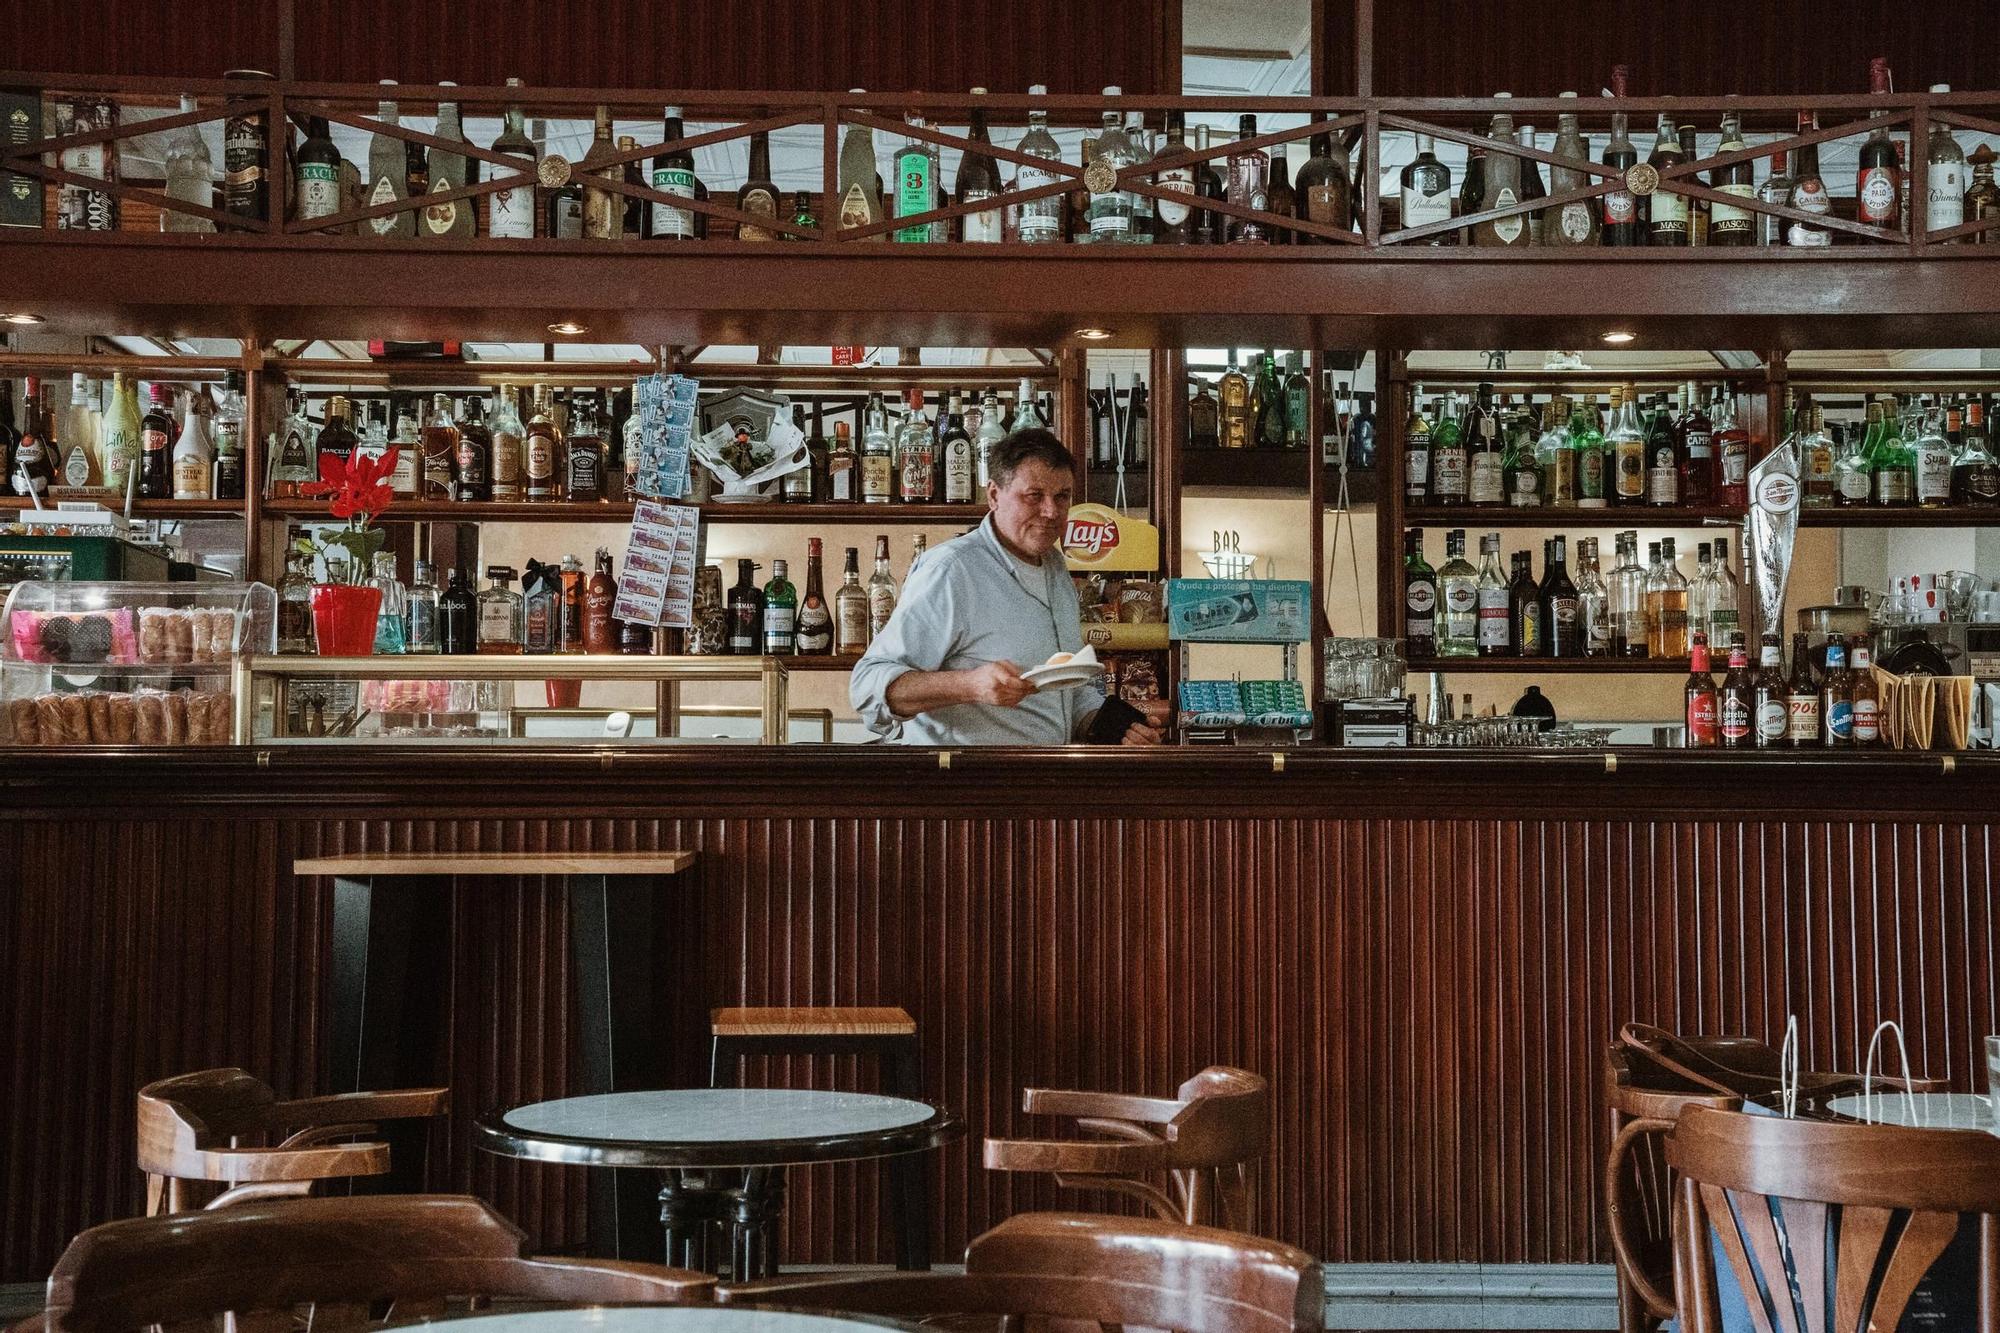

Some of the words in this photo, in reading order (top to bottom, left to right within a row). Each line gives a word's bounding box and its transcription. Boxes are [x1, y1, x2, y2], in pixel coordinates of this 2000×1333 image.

[302, 168, 338, 180] RACIA
[905, 172, 922, 189] 3
[1063, 519, 1115, 554] Lay's
[1213, 530, 1240, 553] BAR
[1089, 629, 1110, 643] Lay's
